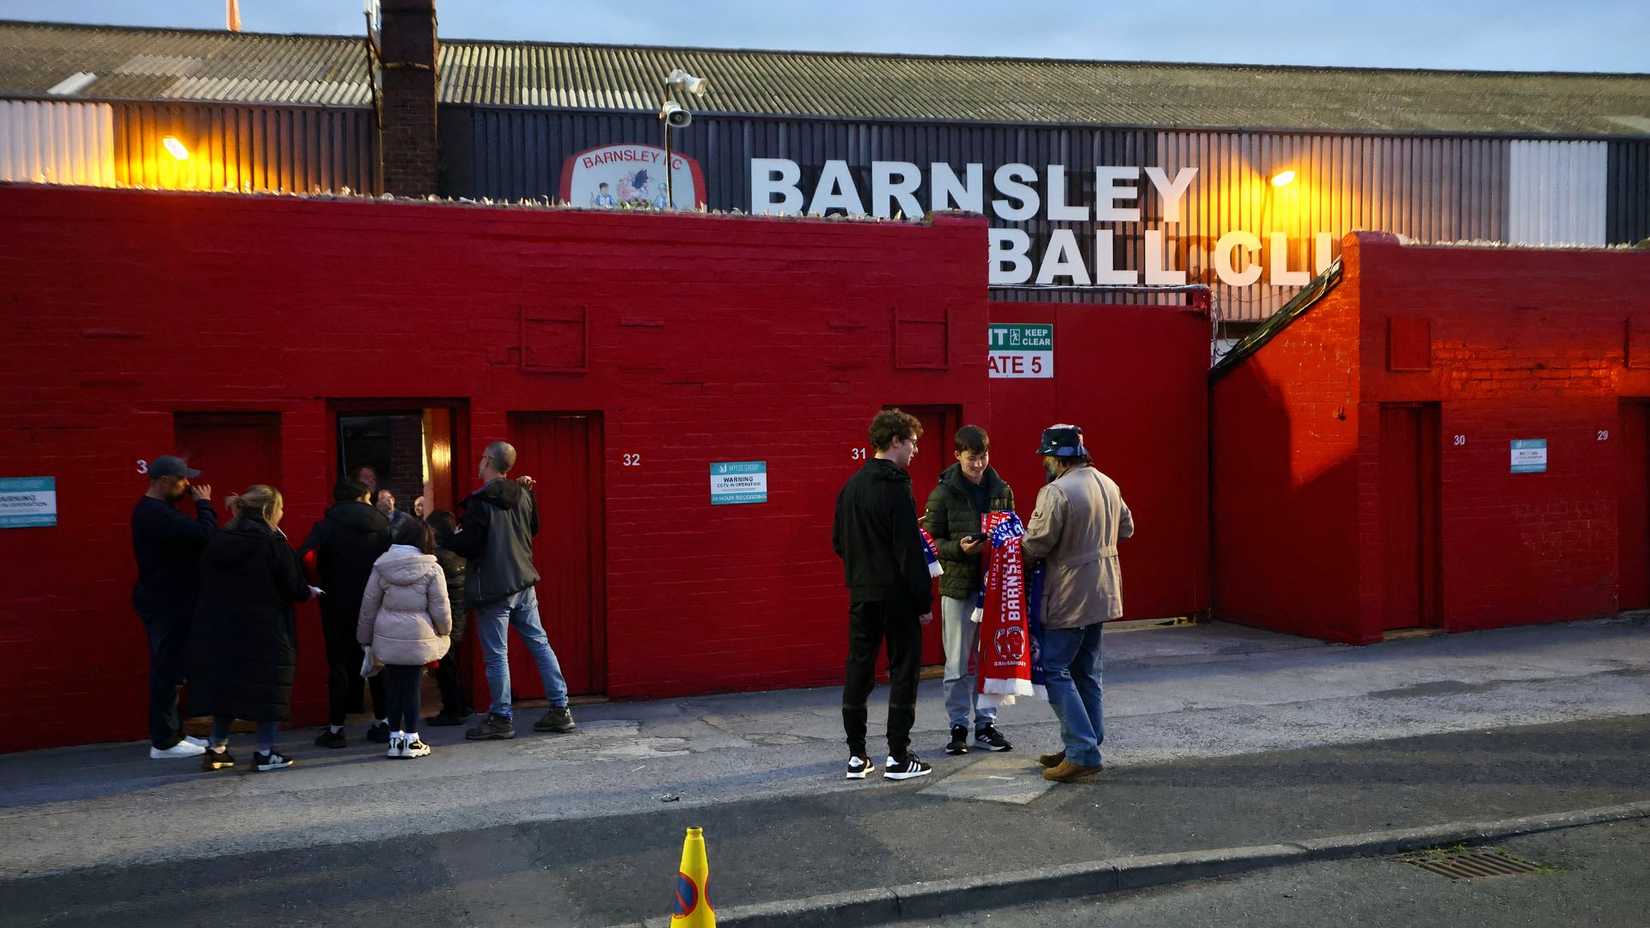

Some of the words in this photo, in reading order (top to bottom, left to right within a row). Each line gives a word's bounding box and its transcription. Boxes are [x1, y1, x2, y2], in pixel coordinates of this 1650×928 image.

[582, 149, 659, 169] BARNSLEY
[751, 158, 1199, 222] BARNSLEY
[987, 228, 1187, 286] BALL
[988, 328, 1008, 346] IT
[1025, 328, 1048, 337] KEEP
[1022, 337, 1050, 346] CLEAR
[988, 356, 1024, 374] ATE
[1031, 356, 1042, 374] 5
[1454, 435, 1465, 445] 30
[623, 453, 641, 466] 32
[851, 447, 866, 460] 31
[135, 458, 149, 475] 3
